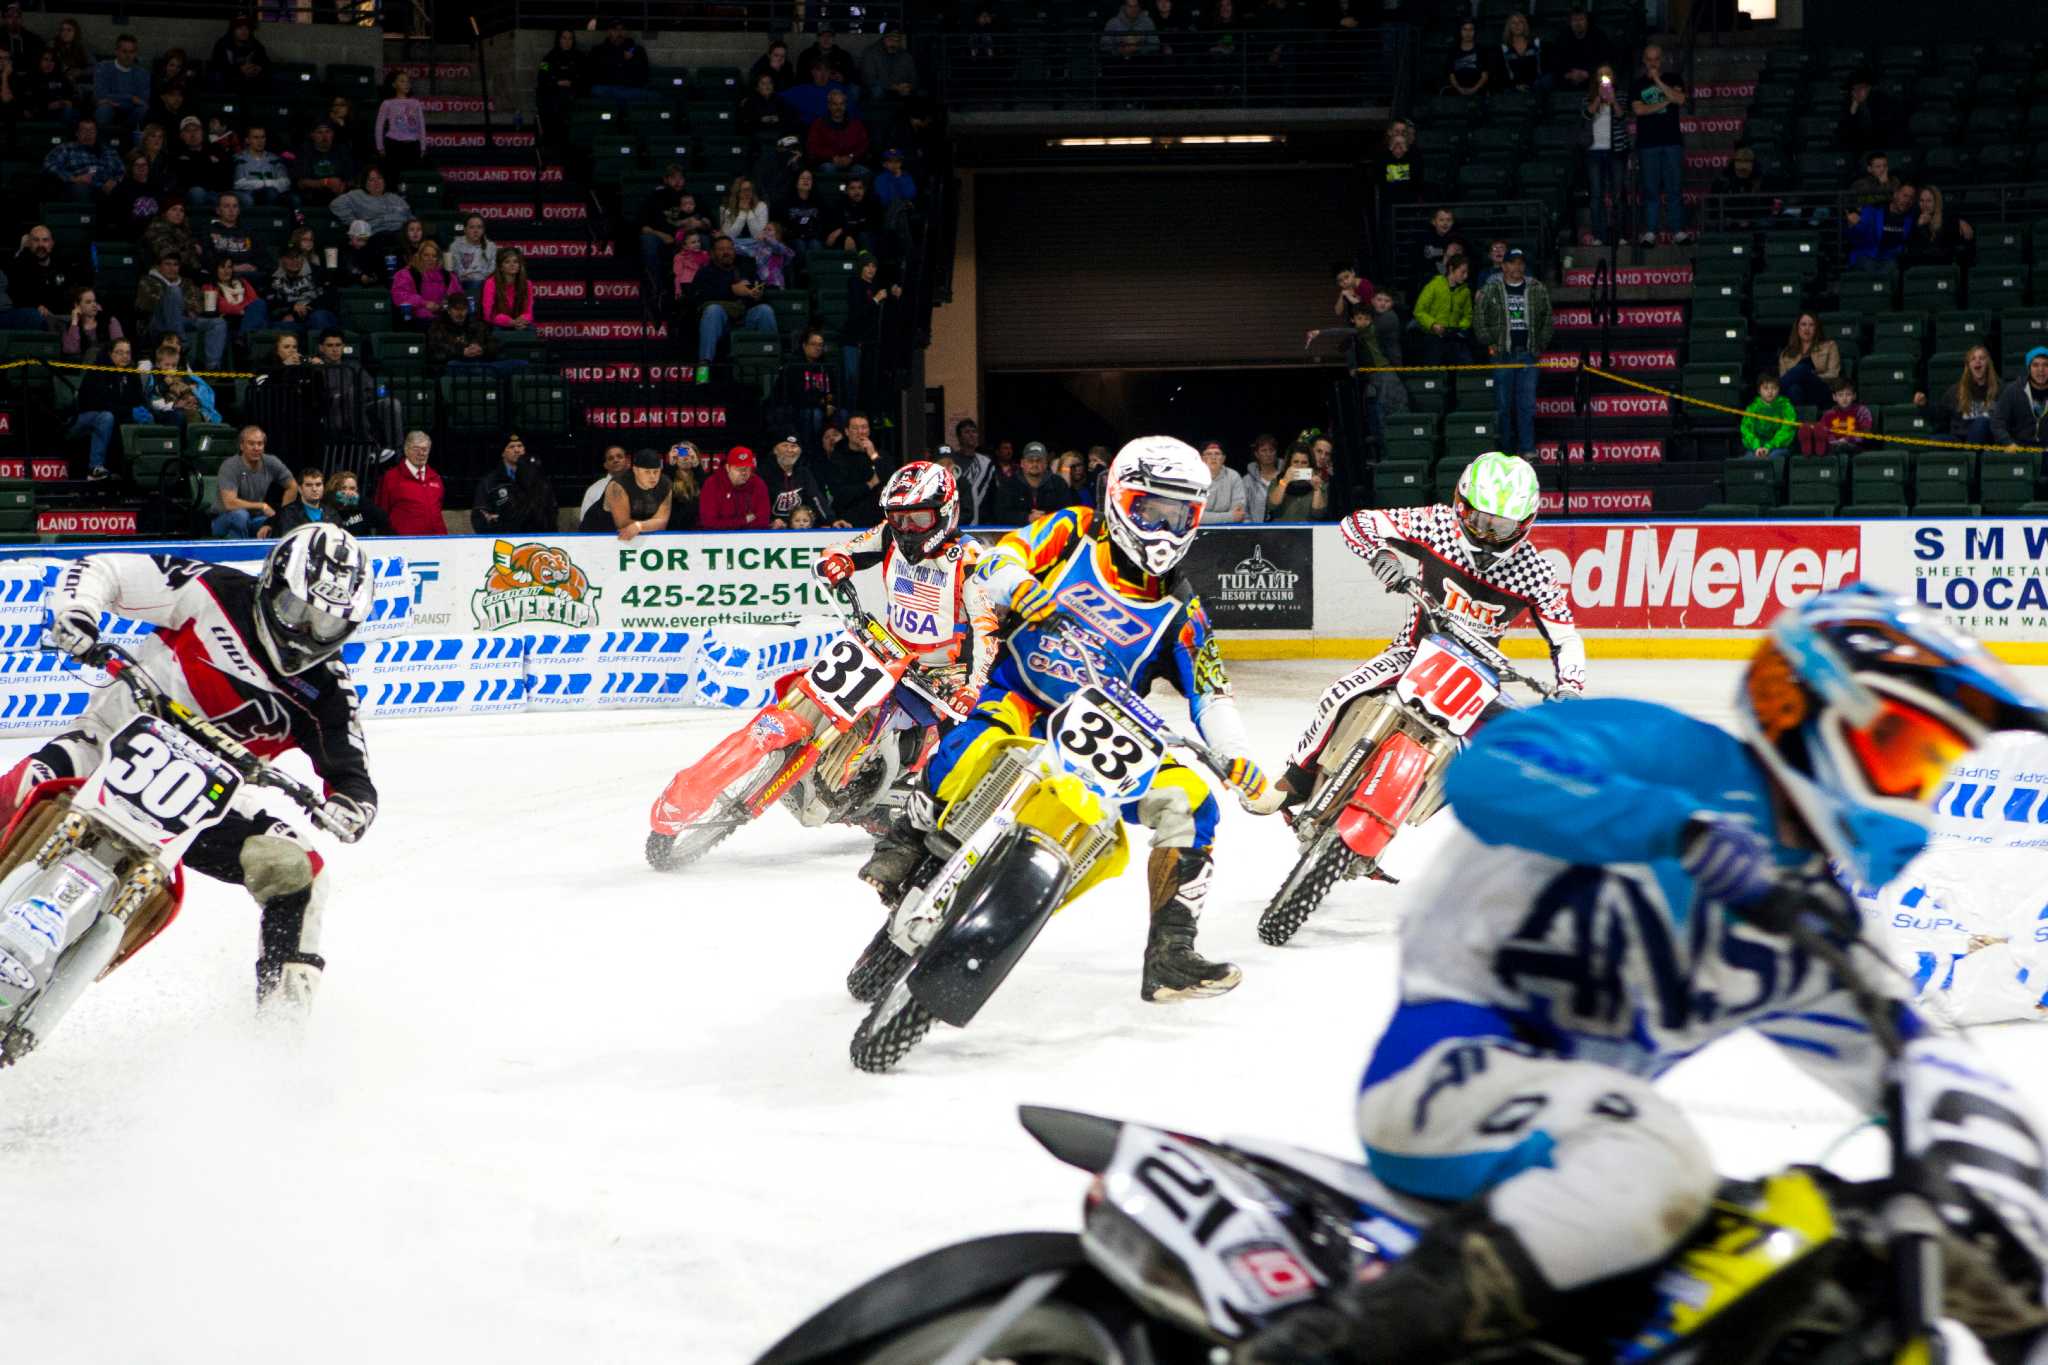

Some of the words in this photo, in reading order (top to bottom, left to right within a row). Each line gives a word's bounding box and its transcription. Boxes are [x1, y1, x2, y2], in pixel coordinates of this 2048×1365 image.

[593, 283, 640, 297] OYOTA
[1628, 311, 1683, 324] TOYOTA
[1619, 355, 1676, 368] TOYOTA
[1611, 399, 1669, 412] TOYOTA
[1603, 447, 1662, 460] TOYOTA
[1592, 495, 1653, 509] TOYOTA
[81, 516, 137, 532] TOYOTA
[619, 549, 690, 571] FOR
[1915, 566, 1977, 577] SHEET
[1218, 572, 1299, 589] TULALIP
[1221, 591, 1258, 601] RESORT
[1260, 591, 1294, 601] CASINO
[413, 612, 452, 625] RANSIT
[894, 604, 939, 637] USA
[210, 625, 257, 678] thor
[598, 655, 685, 664] SUPERTRAPP
[373, 663, 458, 674] SUPERTRAPP
[811, 640, 885, 718] 31
[598, 694, 683, 705] SUPERTRAPP
[374, 704, 459, 717] SUPERTRAPP
[763, 755, 808, 801] DUNLOP
